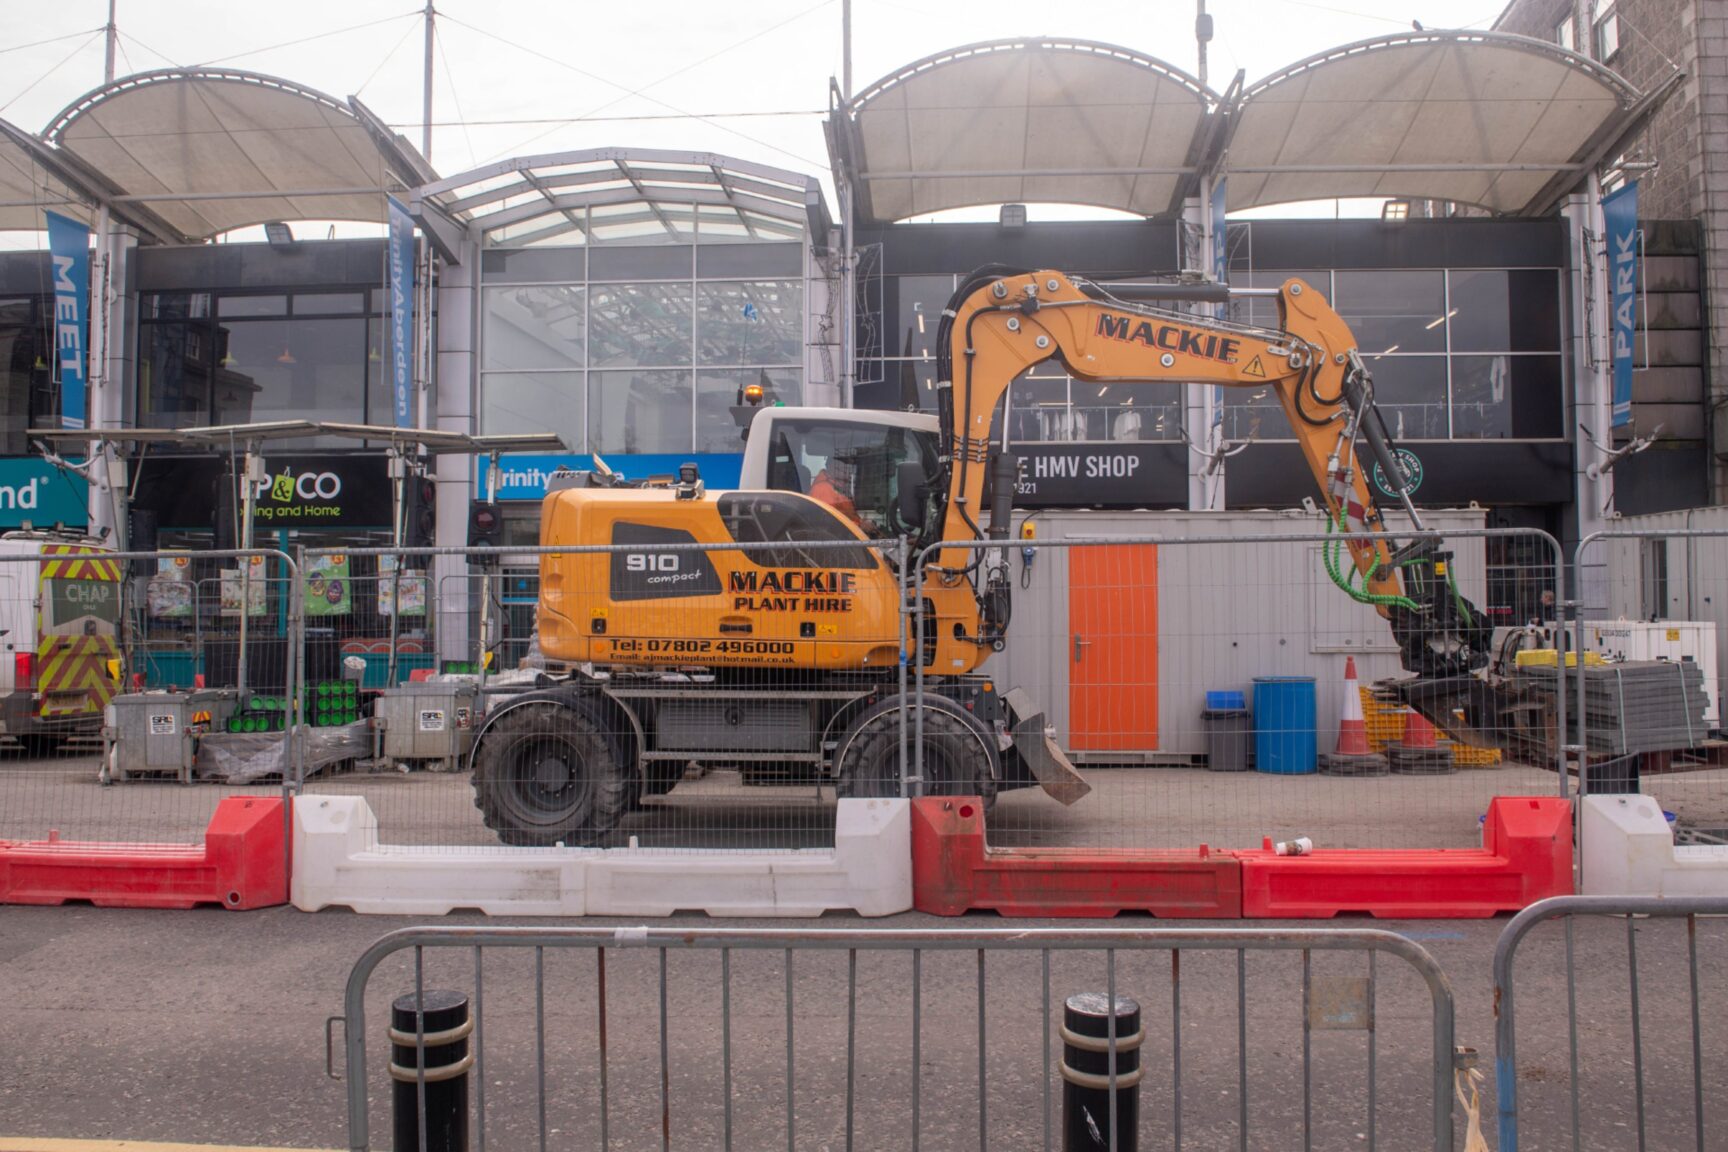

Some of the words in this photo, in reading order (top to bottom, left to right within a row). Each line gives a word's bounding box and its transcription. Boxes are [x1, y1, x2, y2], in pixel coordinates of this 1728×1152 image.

[1616, 228, 1635, 359] PARK
[53, 255, 83, 380] MEET
[1095, 313, 1241, 365] MACKIE
[1035, 456, 1080, 478] HMV
[1086, 455, 1140, 477] SHOP
[501, 468, 551, 491] rinity
[276, 506, 301, 517] and
[305, 506, 341, 517] Home
[626, 554, 680, 571] 910
[647, 569, 702, 584] compact
[728, 571, 857, 595] MACKIE
[65, 584, 109, 603] CHAP
[734, 597, 799, 612] PLANT
[804, 598, 852, 613] HIRE
[610, 639, 643, 651] Tel:
[647, 640, 711, 653] 07802
[715, 641, 795, 654] 496000
